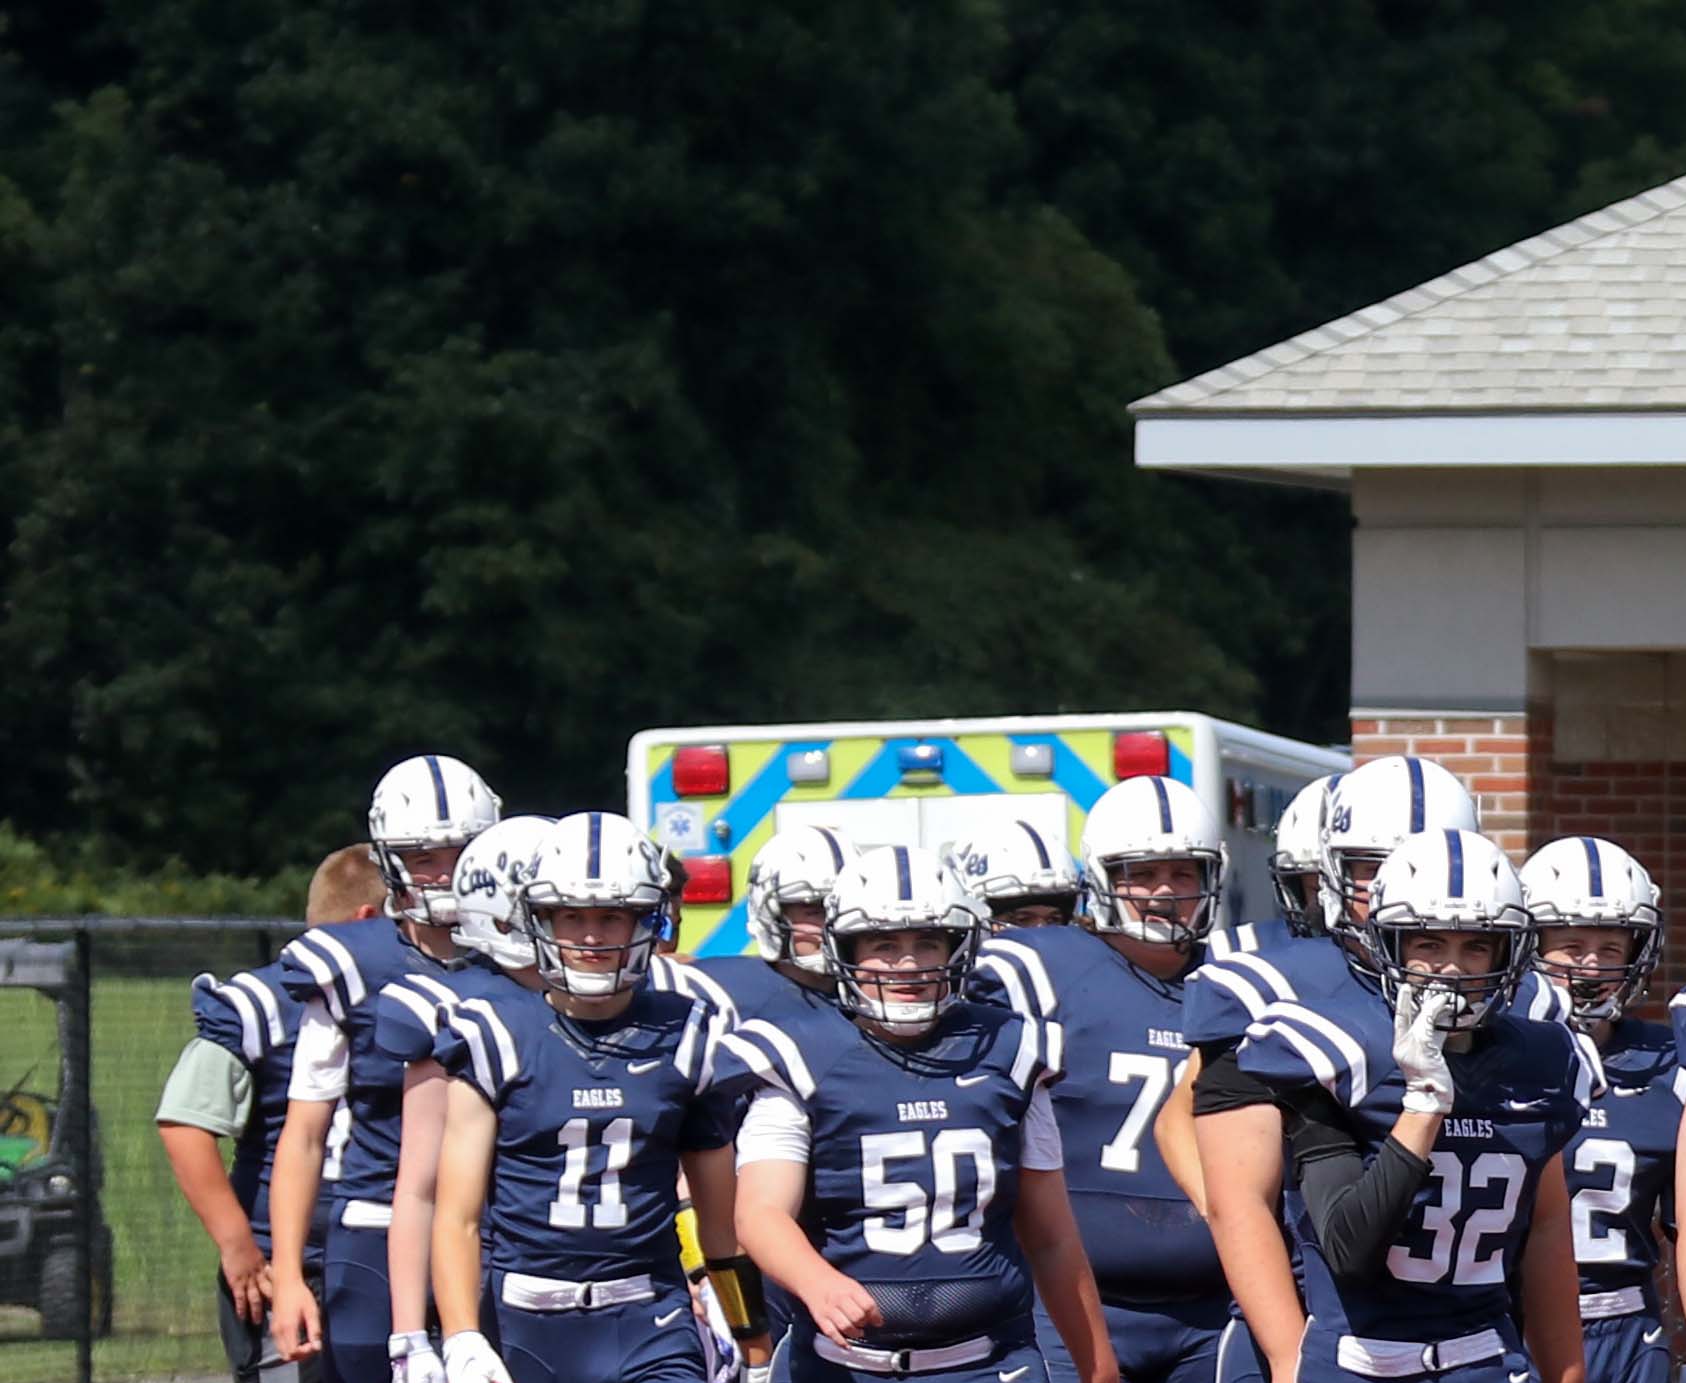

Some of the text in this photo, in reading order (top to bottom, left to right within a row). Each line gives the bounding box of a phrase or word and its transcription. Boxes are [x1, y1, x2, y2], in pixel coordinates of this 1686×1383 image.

[1147, 1028, 1193, 1051] EAGLE
[572, 1086, 624, 1109] EAGLES
[896, 1100, 950, 1122] EAGLES
[1100, 1051, 1190, 1173] 7
[1444, 1118, 1494, 1140] EAGLES
[547, 1117, 634, 1230] 11
[860, 1128, 998, 1256] 50
[1385, 1151, 1528, 1286] 32
